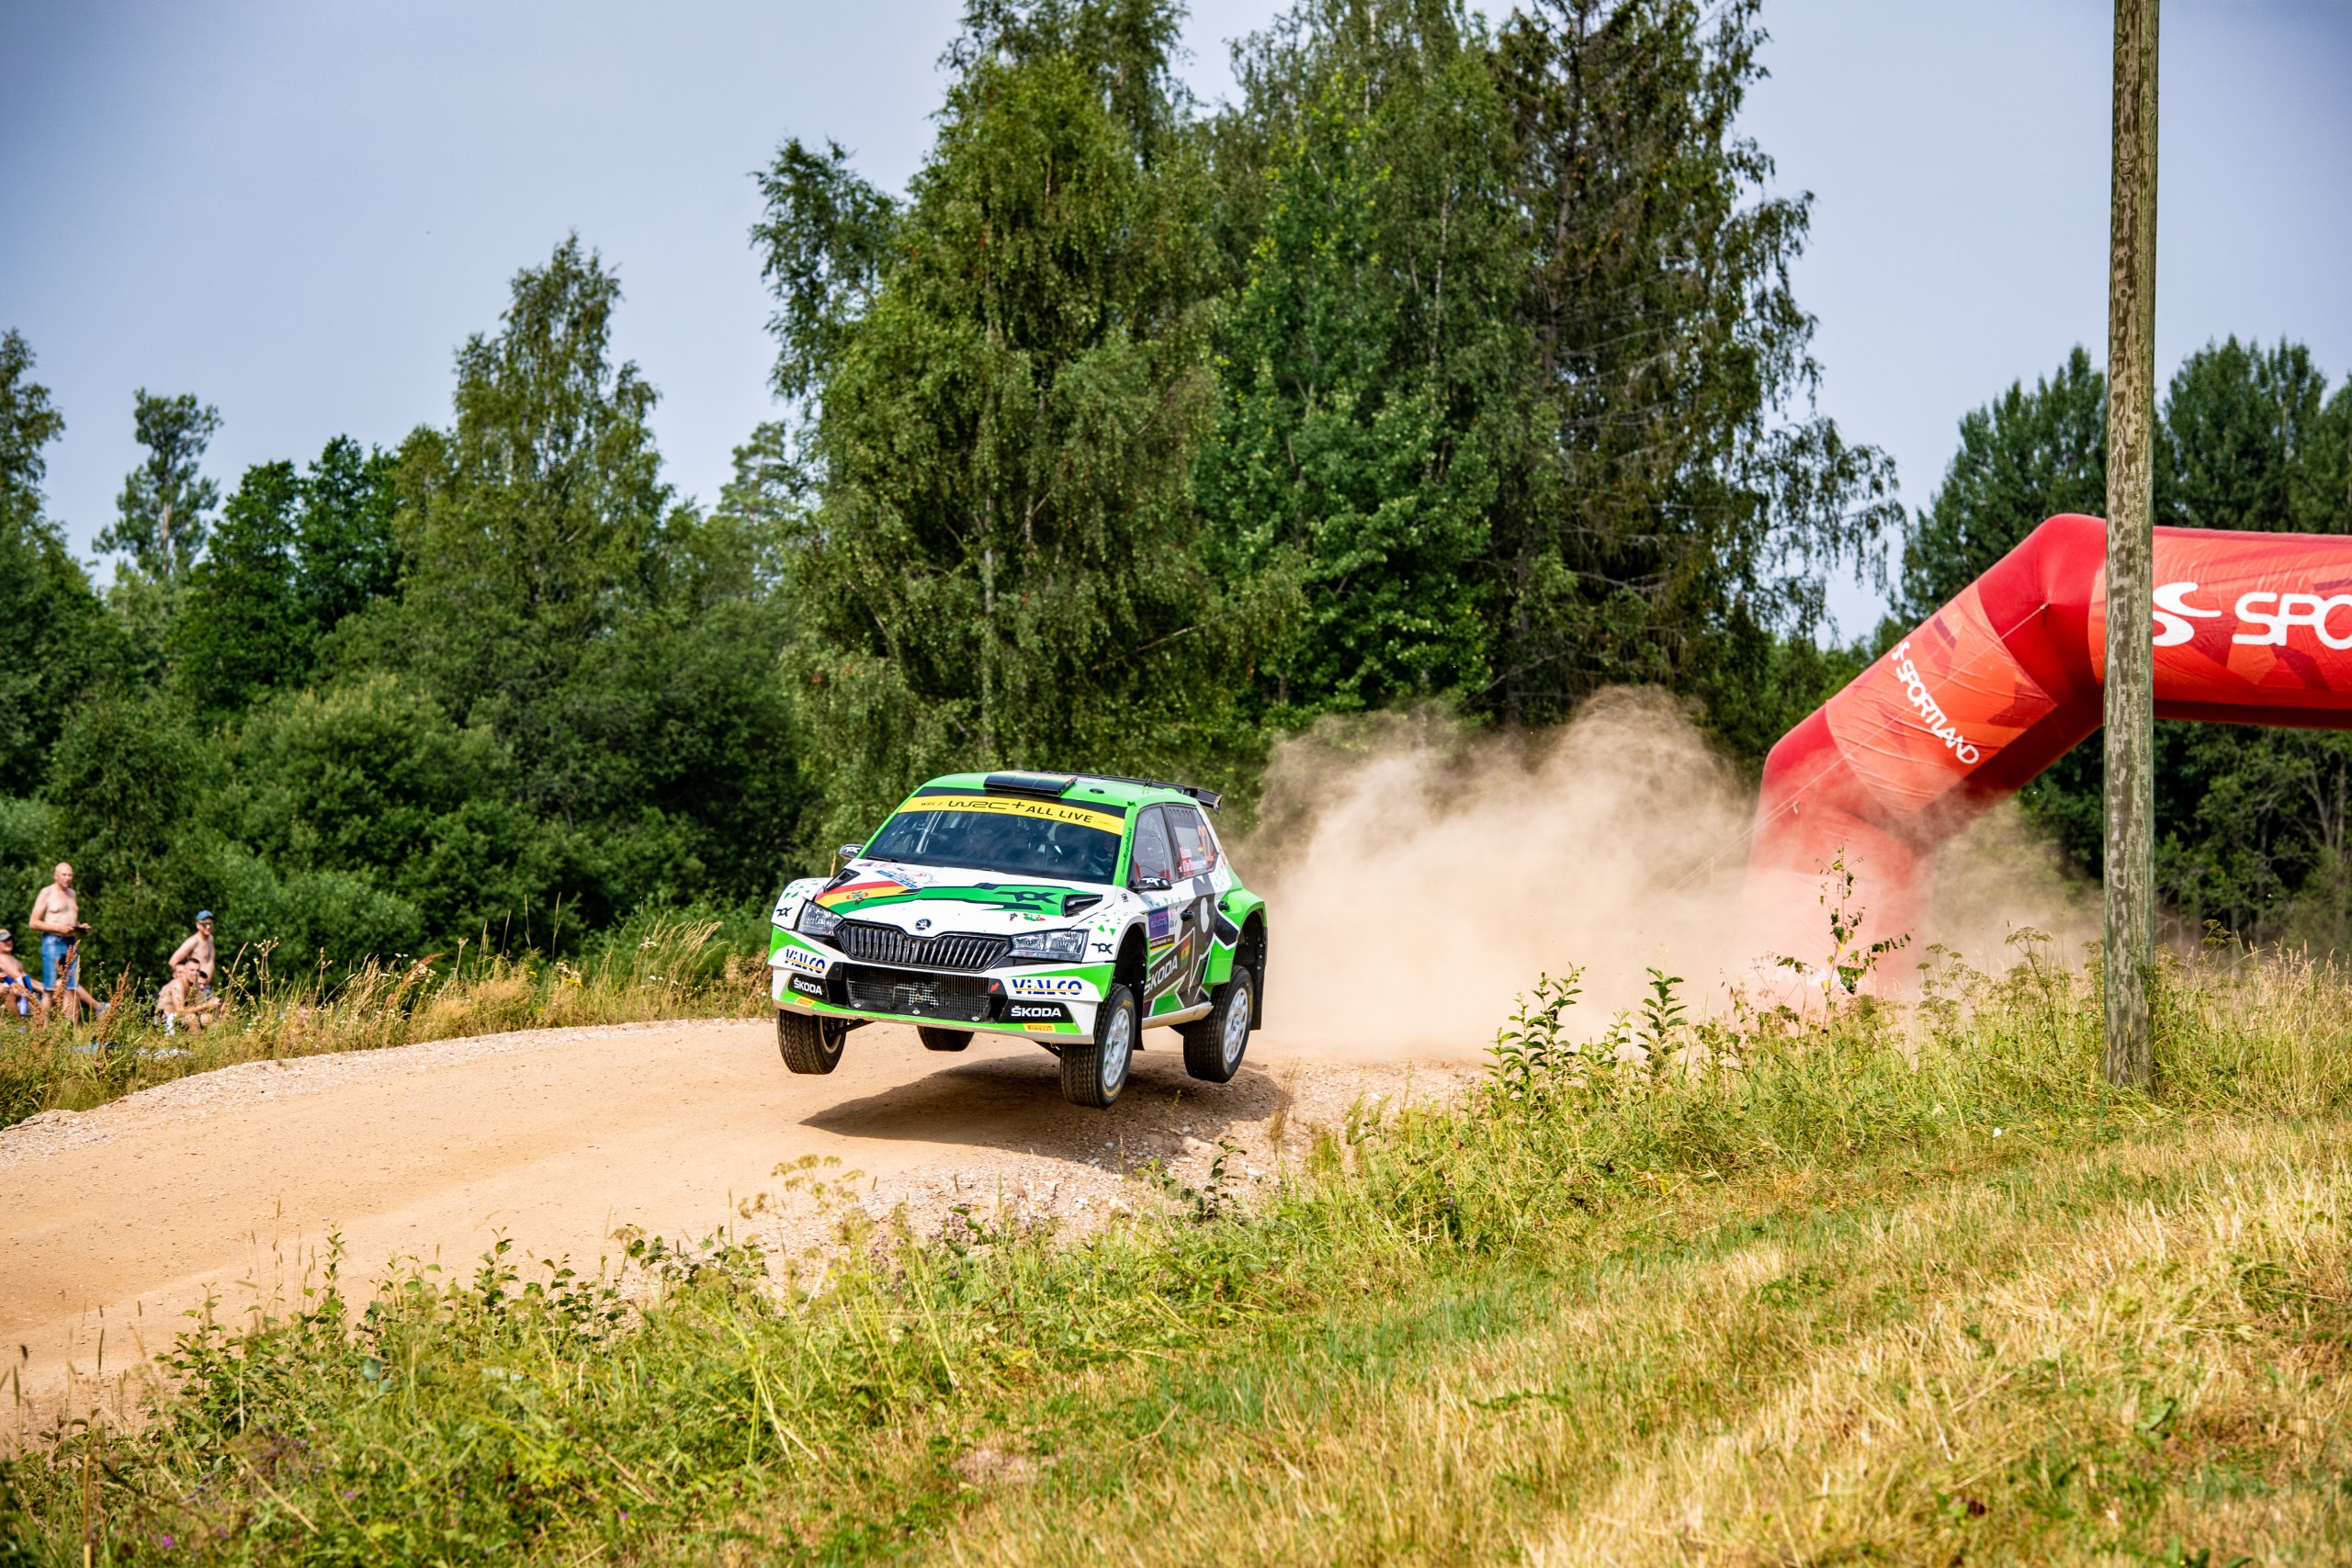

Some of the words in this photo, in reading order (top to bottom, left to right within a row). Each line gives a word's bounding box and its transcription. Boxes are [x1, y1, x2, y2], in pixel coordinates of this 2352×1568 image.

[1895, 659, 1980, 764] SPORTLAND
[1026, 806, 1054, 817] ALL
[1058, 809, 1093, 823] LIVE
[793, 976, 823, 996] ŠKODA
[1011, 1005, 1062, 1017] ŠKODA
